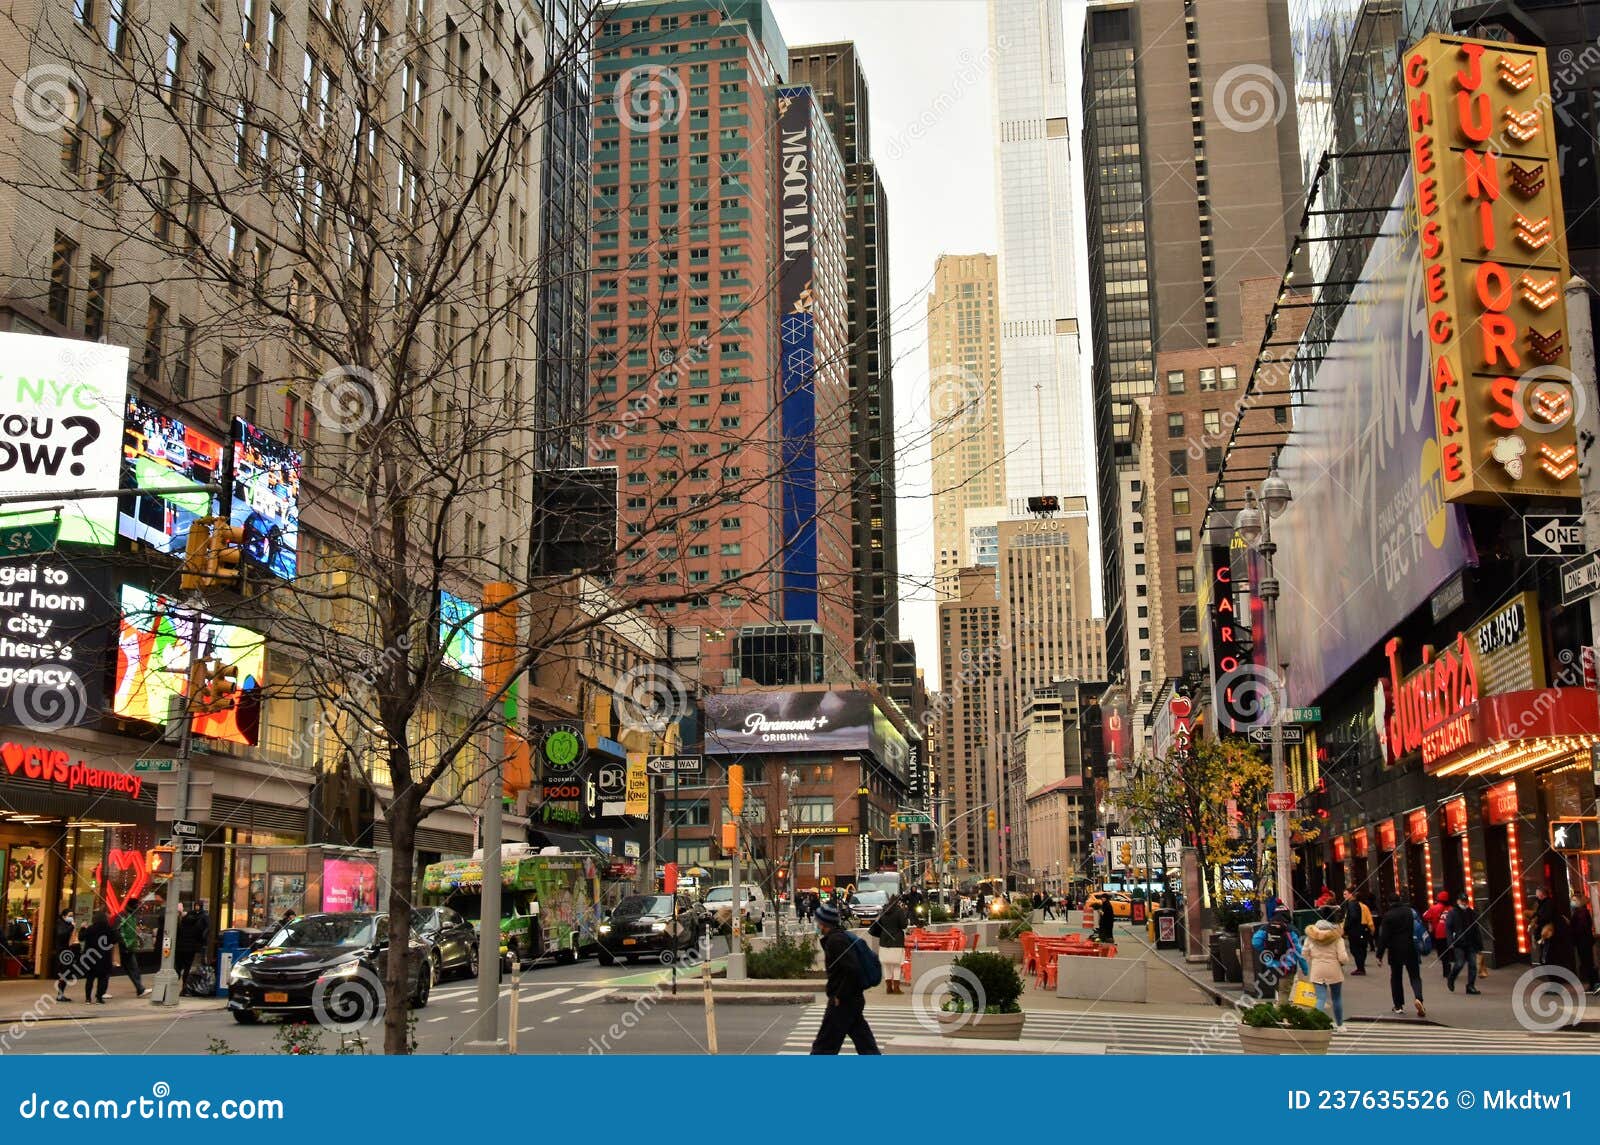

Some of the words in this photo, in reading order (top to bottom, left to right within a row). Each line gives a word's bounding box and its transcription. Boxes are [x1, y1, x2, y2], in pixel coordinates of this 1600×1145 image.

[1457, 43, 1521, 430] JUNIORS
[1406, 54, 1463, 484] CHEESECAKE
[16, 376, 98, 410] NYC
[1025, 521, 1058, 532] 1740
[1545, 528, 1580, 543] ONE
[7, 531, 33, 550] St
[1382, 523, 1409, 593] DEC
[43, 566, 69, 585] to
[1568, 571, 1582, 590] ONE
[30, 588, 85, 612] horn
[7, 612, 53, 638] city
[741, 712, 829, 736] Paramount+
[1294, 709, 1302, 720] W
[1303, 709, 1313, 720] 49
[762, 733, 810, 742] ORIGINAL
[1255, 730, 1272, 738] ONE
[1423, 712, 1473, 764] RESTAURANT
[24, 745, 70, 783] CVS
[69, 759, 142, 799] pharmacy
[653, 760, 670, 769] ONE
[678, 760, 697, 769] WAY
[543, 785, 580, 798] FOOD
[629, 780, 645, 789] LION
[627, 790, 648, 801] KING
